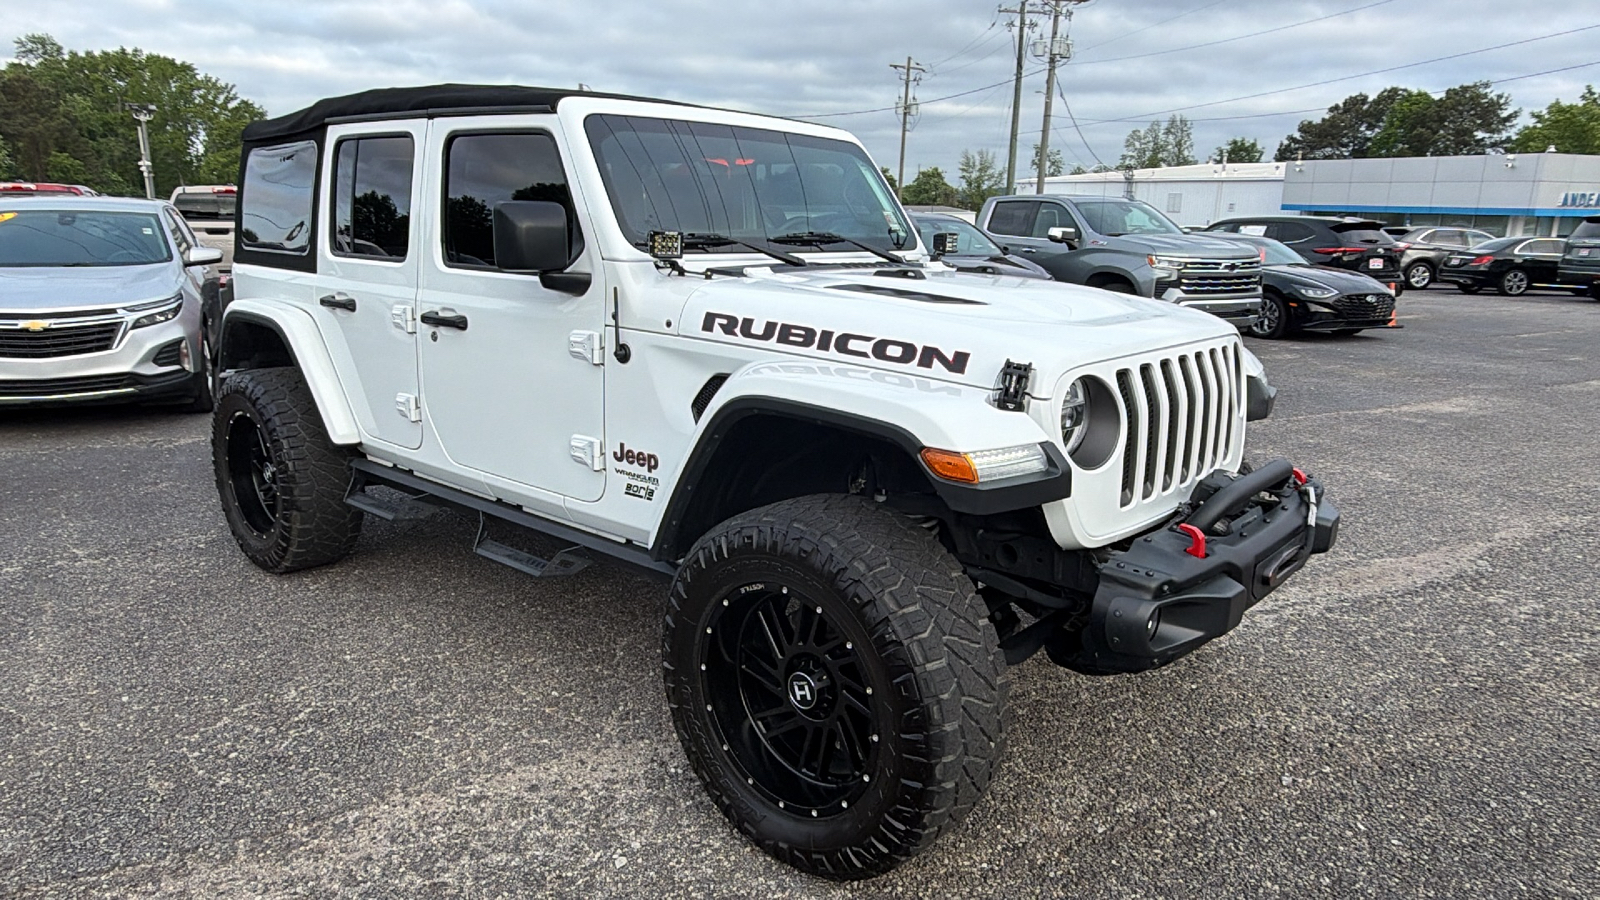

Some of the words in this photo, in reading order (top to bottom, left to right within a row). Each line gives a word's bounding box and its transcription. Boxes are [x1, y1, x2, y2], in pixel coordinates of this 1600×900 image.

[701, 311, 971, 374] RUBICON
[613, 441, 659, 474] Jeep
[614, 467, 659, 483] WRANGLER
